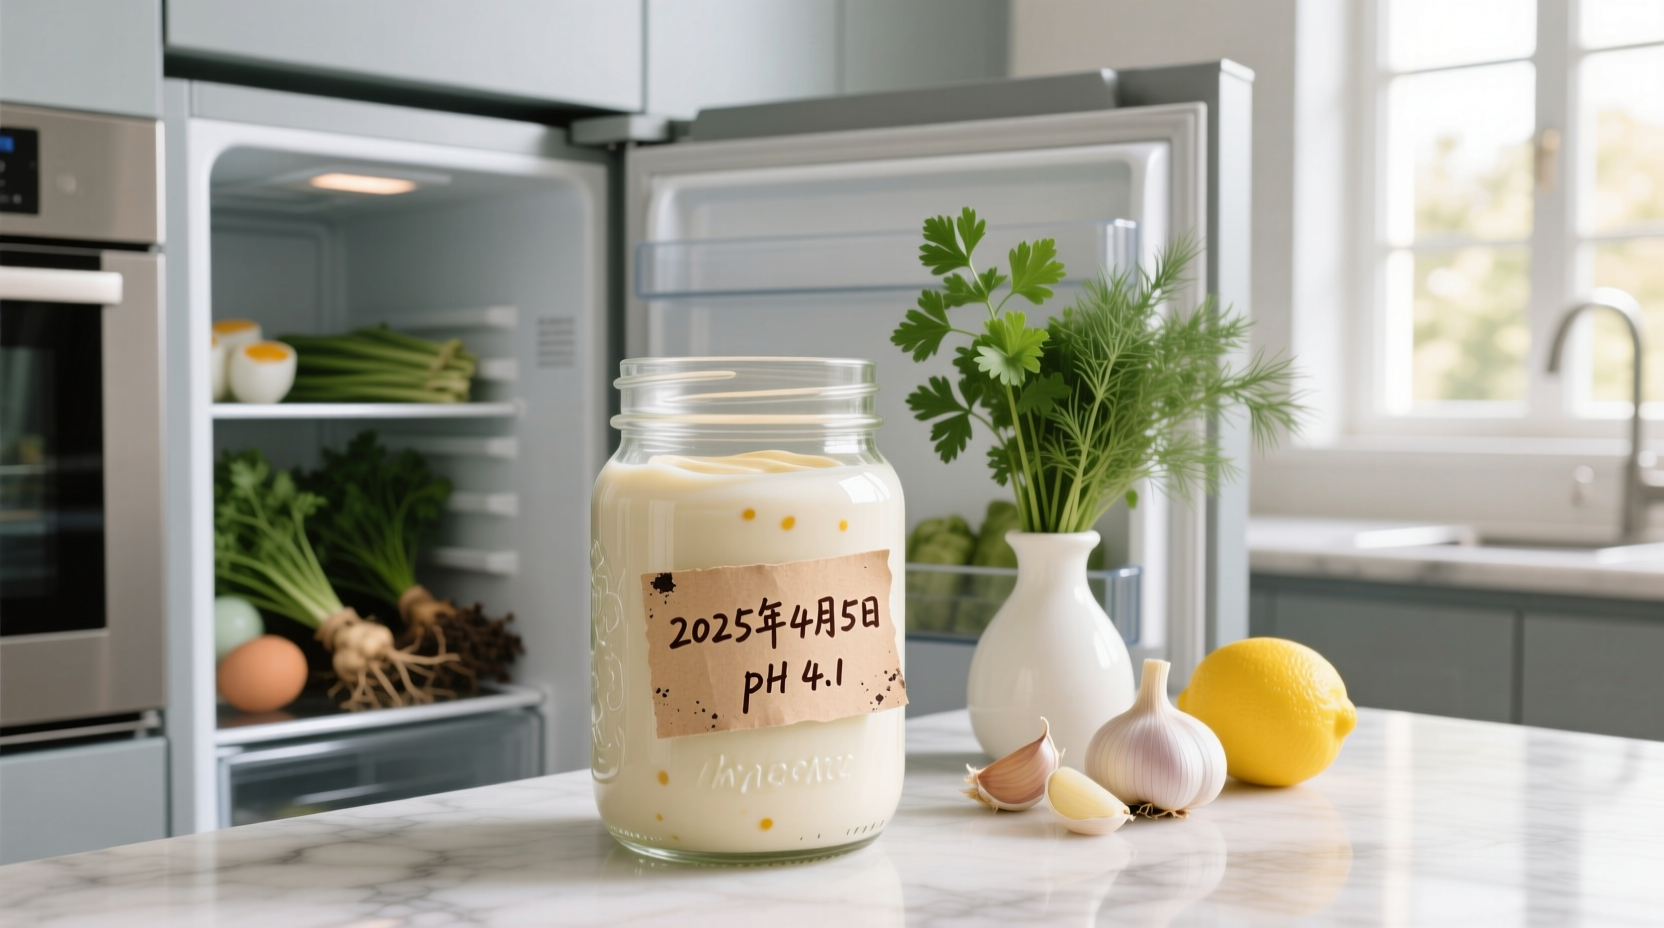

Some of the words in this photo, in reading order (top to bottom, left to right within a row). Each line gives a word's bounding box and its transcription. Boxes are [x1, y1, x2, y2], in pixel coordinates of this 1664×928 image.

[669, 596, 880, 650] 2025年4月5日
[742, 660, 788, 714] pH
[801, 658, 843, 691] 4.1
